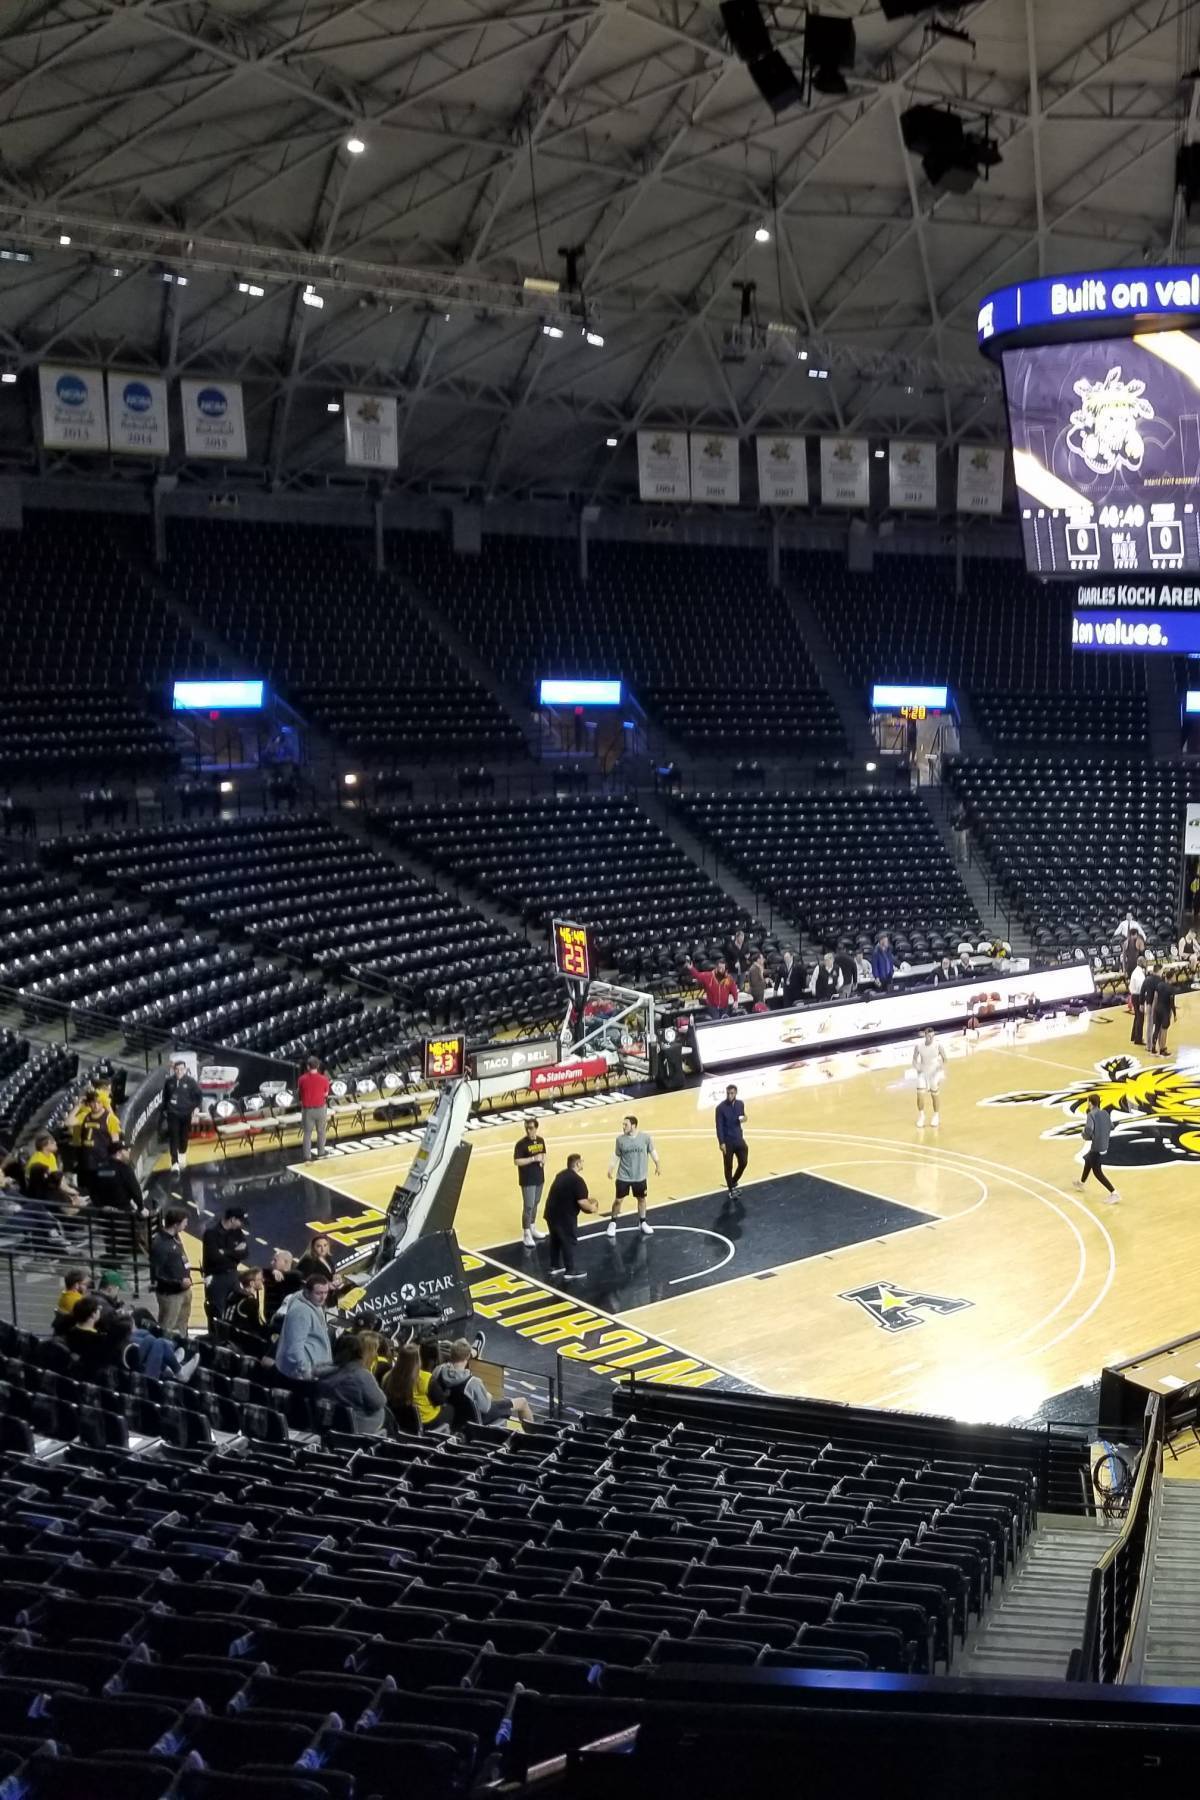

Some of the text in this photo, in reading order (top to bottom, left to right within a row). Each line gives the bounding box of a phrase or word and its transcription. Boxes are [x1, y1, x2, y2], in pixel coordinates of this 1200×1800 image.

[1052, 280, 1106, 315] Built
[1112, 282, 1148, 309] on
[1077, 529, 1088, 551] 0
[1160, 527, 1172, 549] 0
[1118, 585, 1155, 606] KOCH
[1095, 618, 1168, 646] values.
[565, 943, 585, 974] 23
[433, 1054, 454, 1072] 23
[483, 1050, 550, 1070] TACO BELL
[345, 1275, 455, 1319] KANSAS STAR
